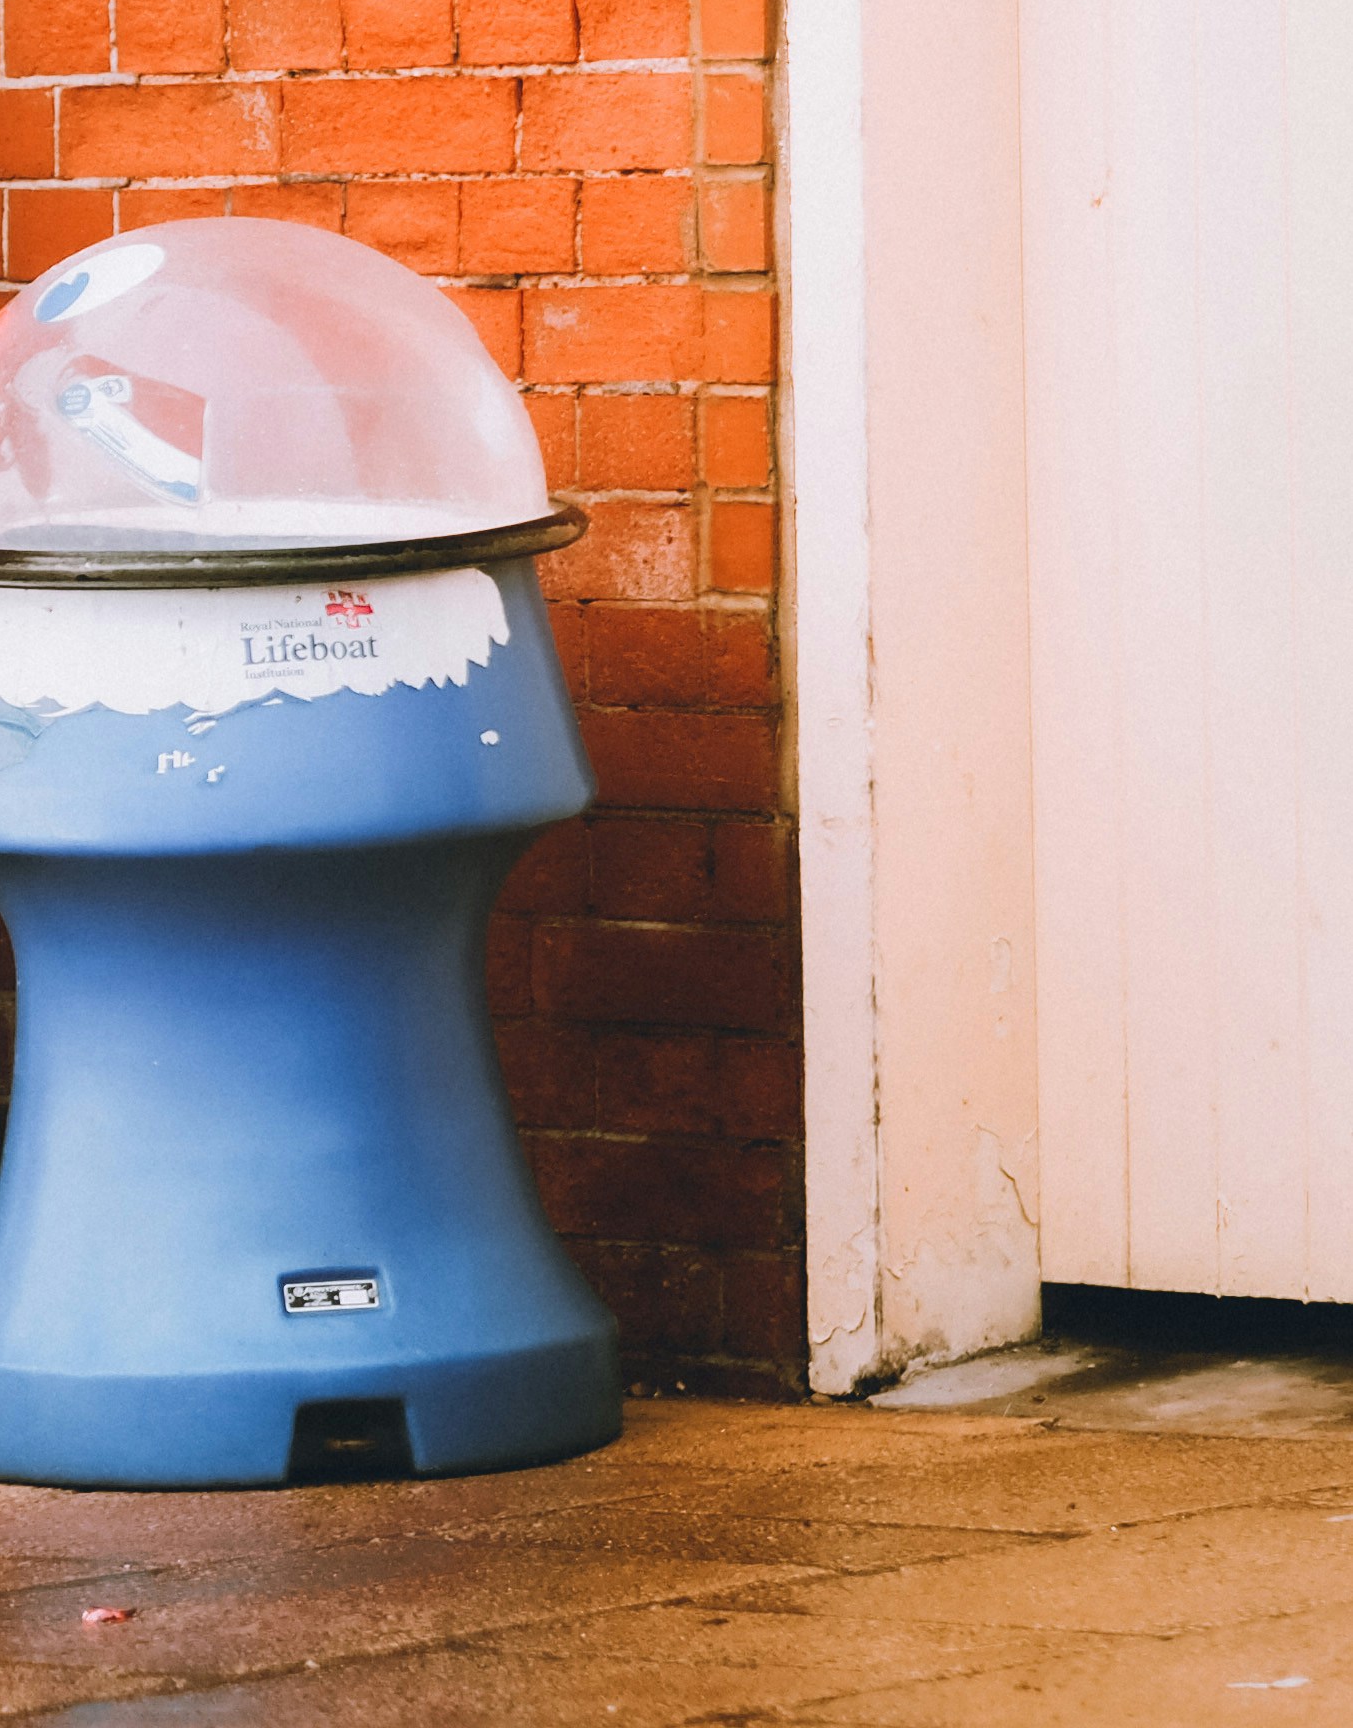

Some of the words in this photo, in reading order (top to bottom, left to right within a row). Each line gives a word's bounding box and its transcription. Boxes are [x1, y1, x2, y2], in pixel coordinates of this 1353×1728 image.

[240, 620, 272, 633] Royal
[275, 616, 323, 631] National
[240, 633, 379, 666] Lifeboat
[244, 666, 305, 680] Institution
